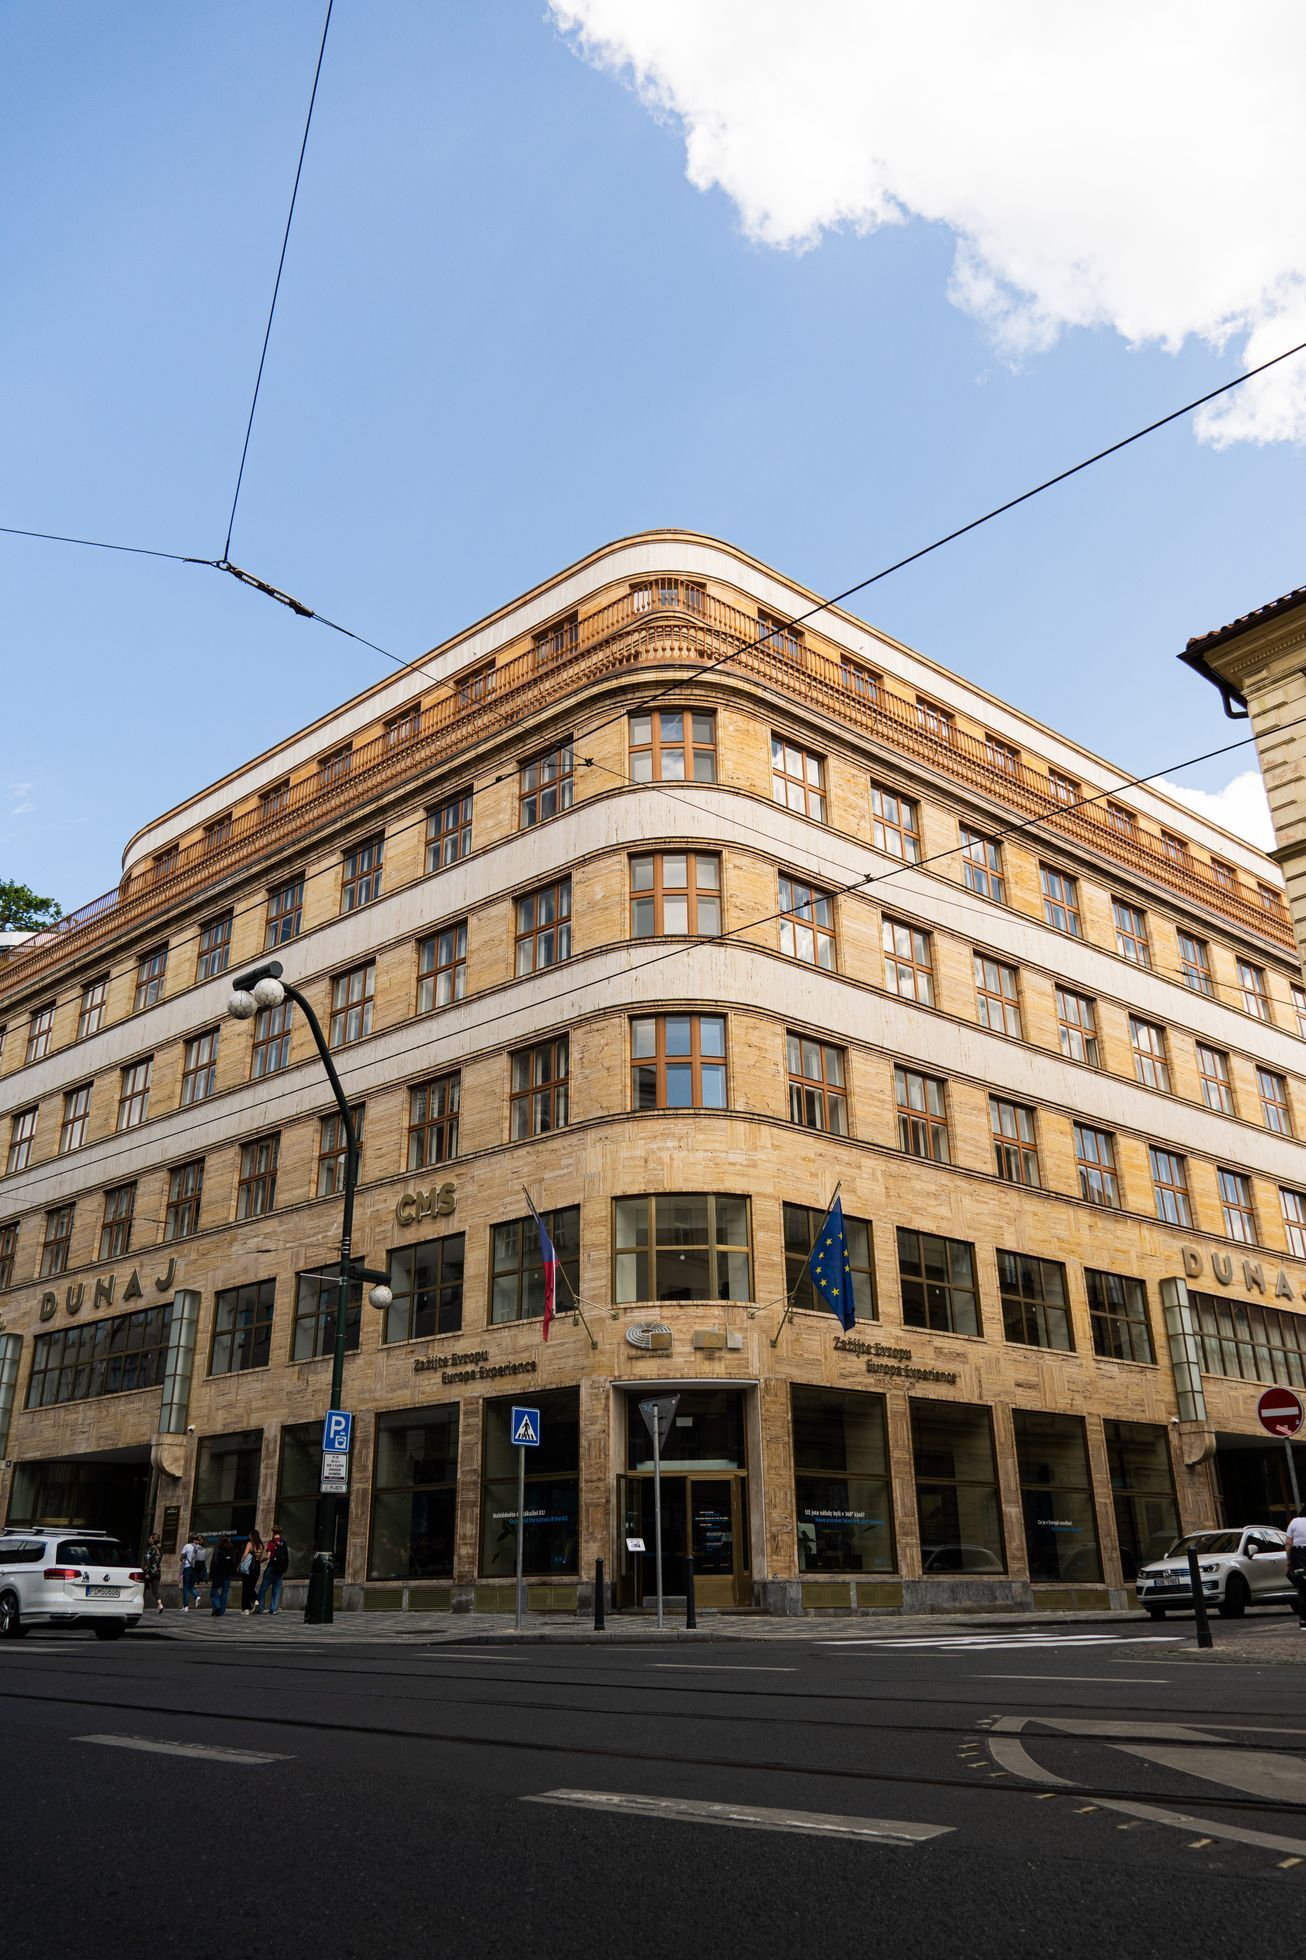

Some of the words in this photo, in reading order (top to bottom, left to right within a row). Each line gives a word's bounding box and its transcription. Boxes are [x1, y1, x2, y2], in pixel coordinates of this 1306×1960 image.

[396, 1182, 457, 1226] CMS
[1182, 1244, 1306, 1302] DUNA
[39, 1257, 177, 1322] DUNAJ
[413, 1355, 449, 1372] Zažijte
[451, 1350, 489, 1367] Evropu
[833, 1336, 872, 1358] Zažijte
[874, 1342, 913, 1362] Evropu
[479, 1360, 537, 1381] Experience
[903, 1364, 957, 1385] Experience
[329, 1415, 346, 1439] P
